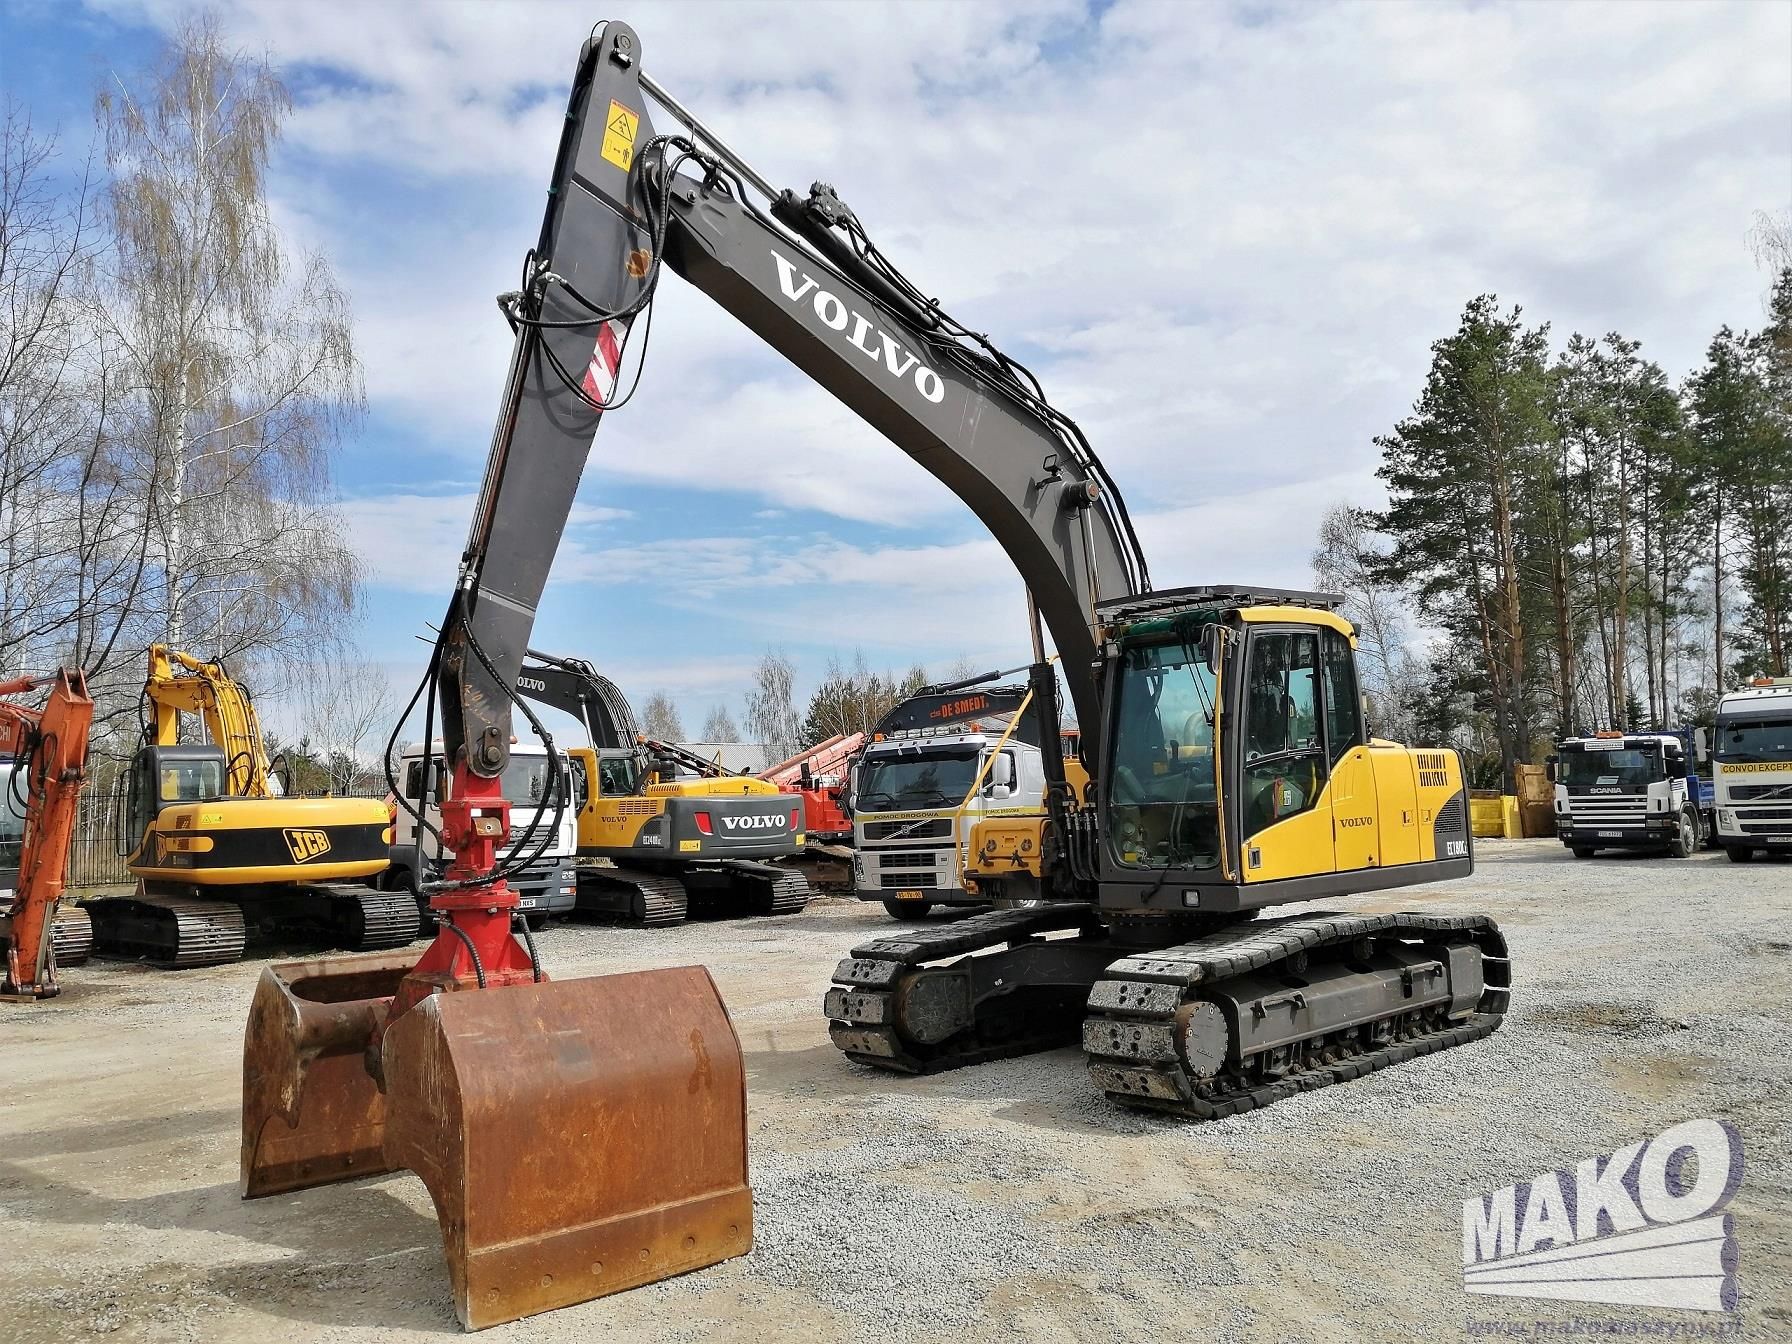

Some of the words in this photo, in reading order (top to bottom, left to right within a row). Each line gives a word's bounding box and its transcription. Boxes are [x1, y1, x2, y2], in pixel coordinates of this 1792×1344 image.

[770, 249, 946, 404] VOLVO
[517, 676, 546, 691] OLVO
[942, 704, 953, 718] DE
[1722, 764, 1757, 773] CONVOI
[721, 814, 786, 830] VOLVO
[1340, 816, 1373, 828] VOLVO
[291, 831, 329, 861] JCB
